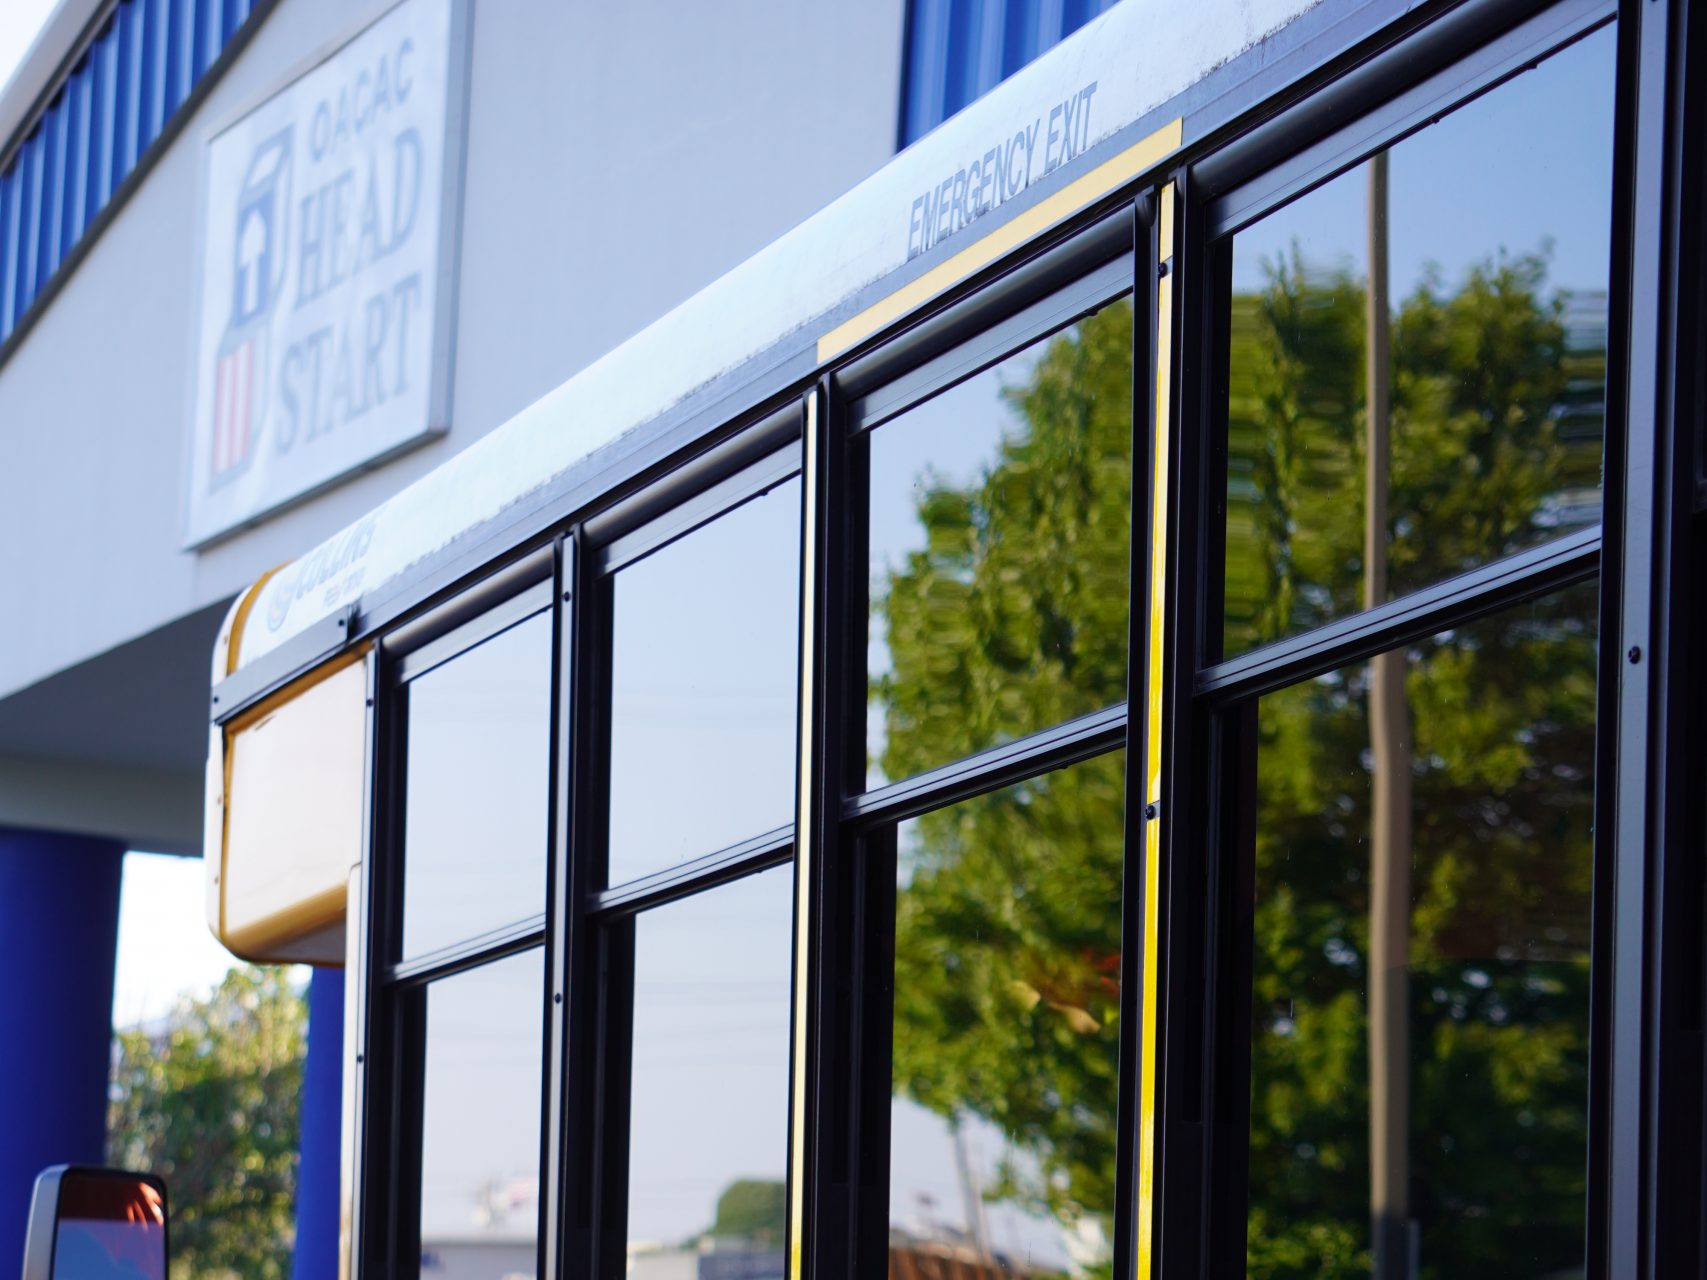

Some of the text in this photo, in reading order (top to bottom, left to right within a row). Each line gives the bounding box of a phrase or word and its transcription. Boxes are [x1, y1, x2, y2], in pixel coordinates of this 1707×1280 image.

[308, 37, 415, 163] OACAC
[907, 80, 1098, 262] EMERGENCY EXIT
[293, 126, 424, 312] HEAD
[276, 272, 421, 457] START
